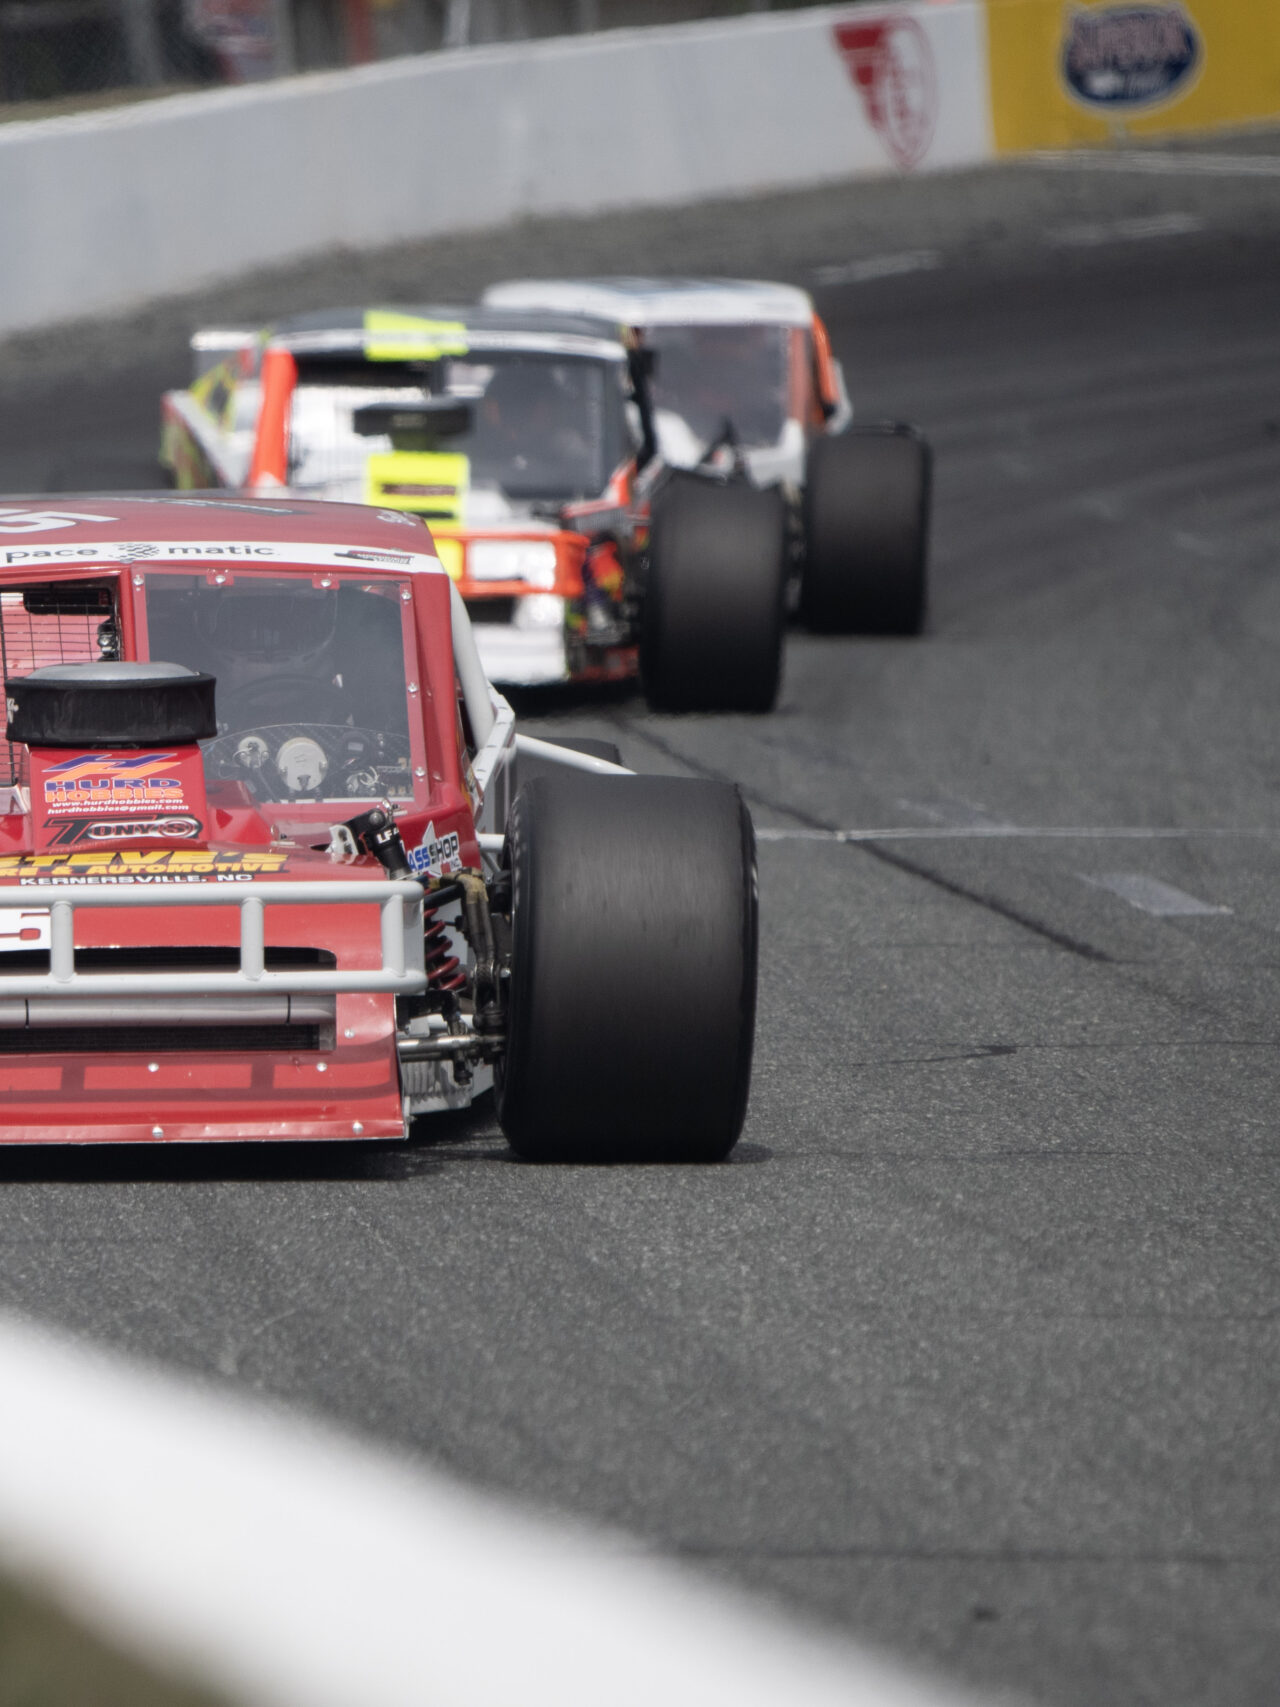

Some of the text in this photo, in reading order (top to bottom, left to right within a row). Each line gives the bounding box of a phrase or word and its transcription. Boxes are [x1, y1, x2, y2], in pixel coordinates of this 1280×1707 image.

[169, 543, 274, 556] matic
[5, 549, 98, 563] pace
[44, 778, 181, 792] HURD
[45, 788, 184, 802] HOBBIES
[52, 798, 183, 808] www.hurdhobbies.com
[48, 804, 190, 815] hurdhobbies@gmail.com
[51, 866, 72, 875] &
[86, 863, 280, 874] AUTOMOTIVE
[217, 874, 253, 882] NC
